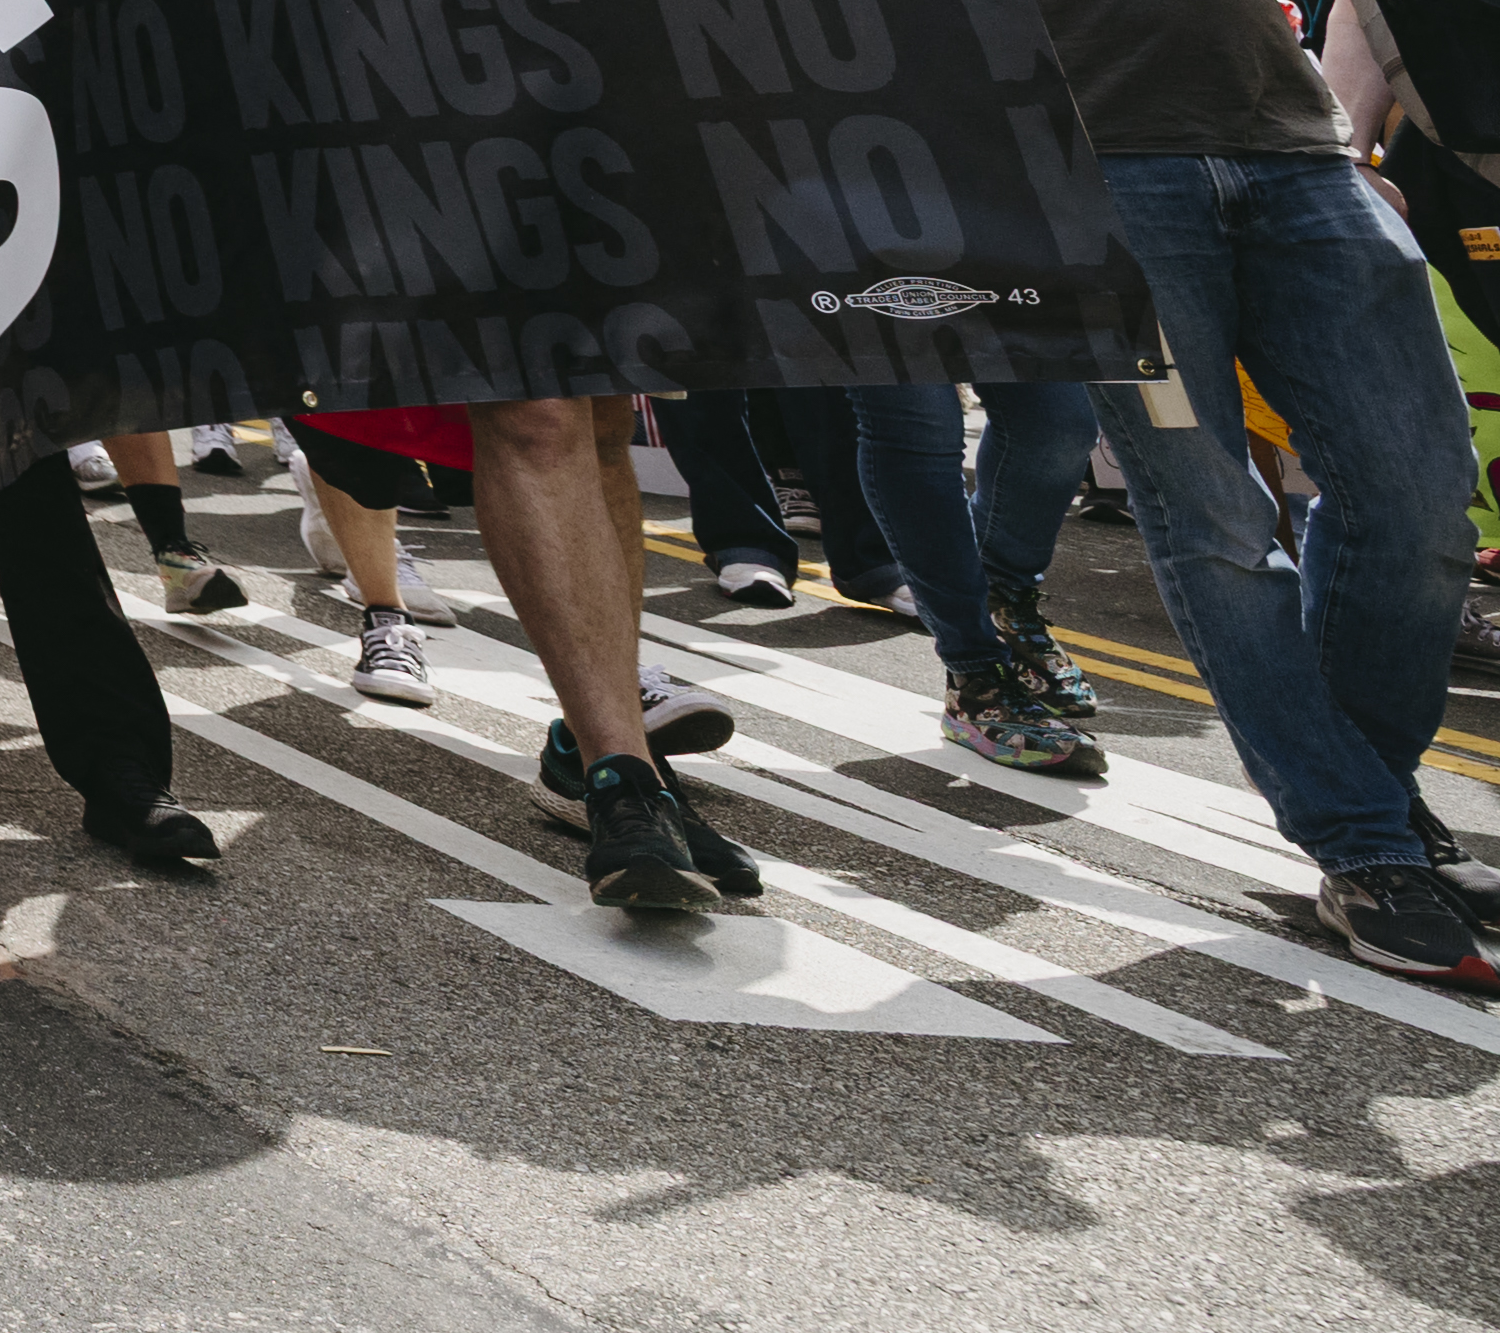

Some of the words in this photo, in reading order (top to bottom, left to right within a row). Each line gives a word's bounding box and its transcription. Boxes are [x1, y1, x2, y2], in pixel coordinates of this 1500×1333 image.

[250, 126, 660, 303] KINGS
[696, 113, 966, 277] NO
[855, 294, 899, 305] TRADES
[939, 293, 989, 302] COUNCIL
[901, 290, 935, 299] UNION
[1007, 288, 1041, 305] 43
